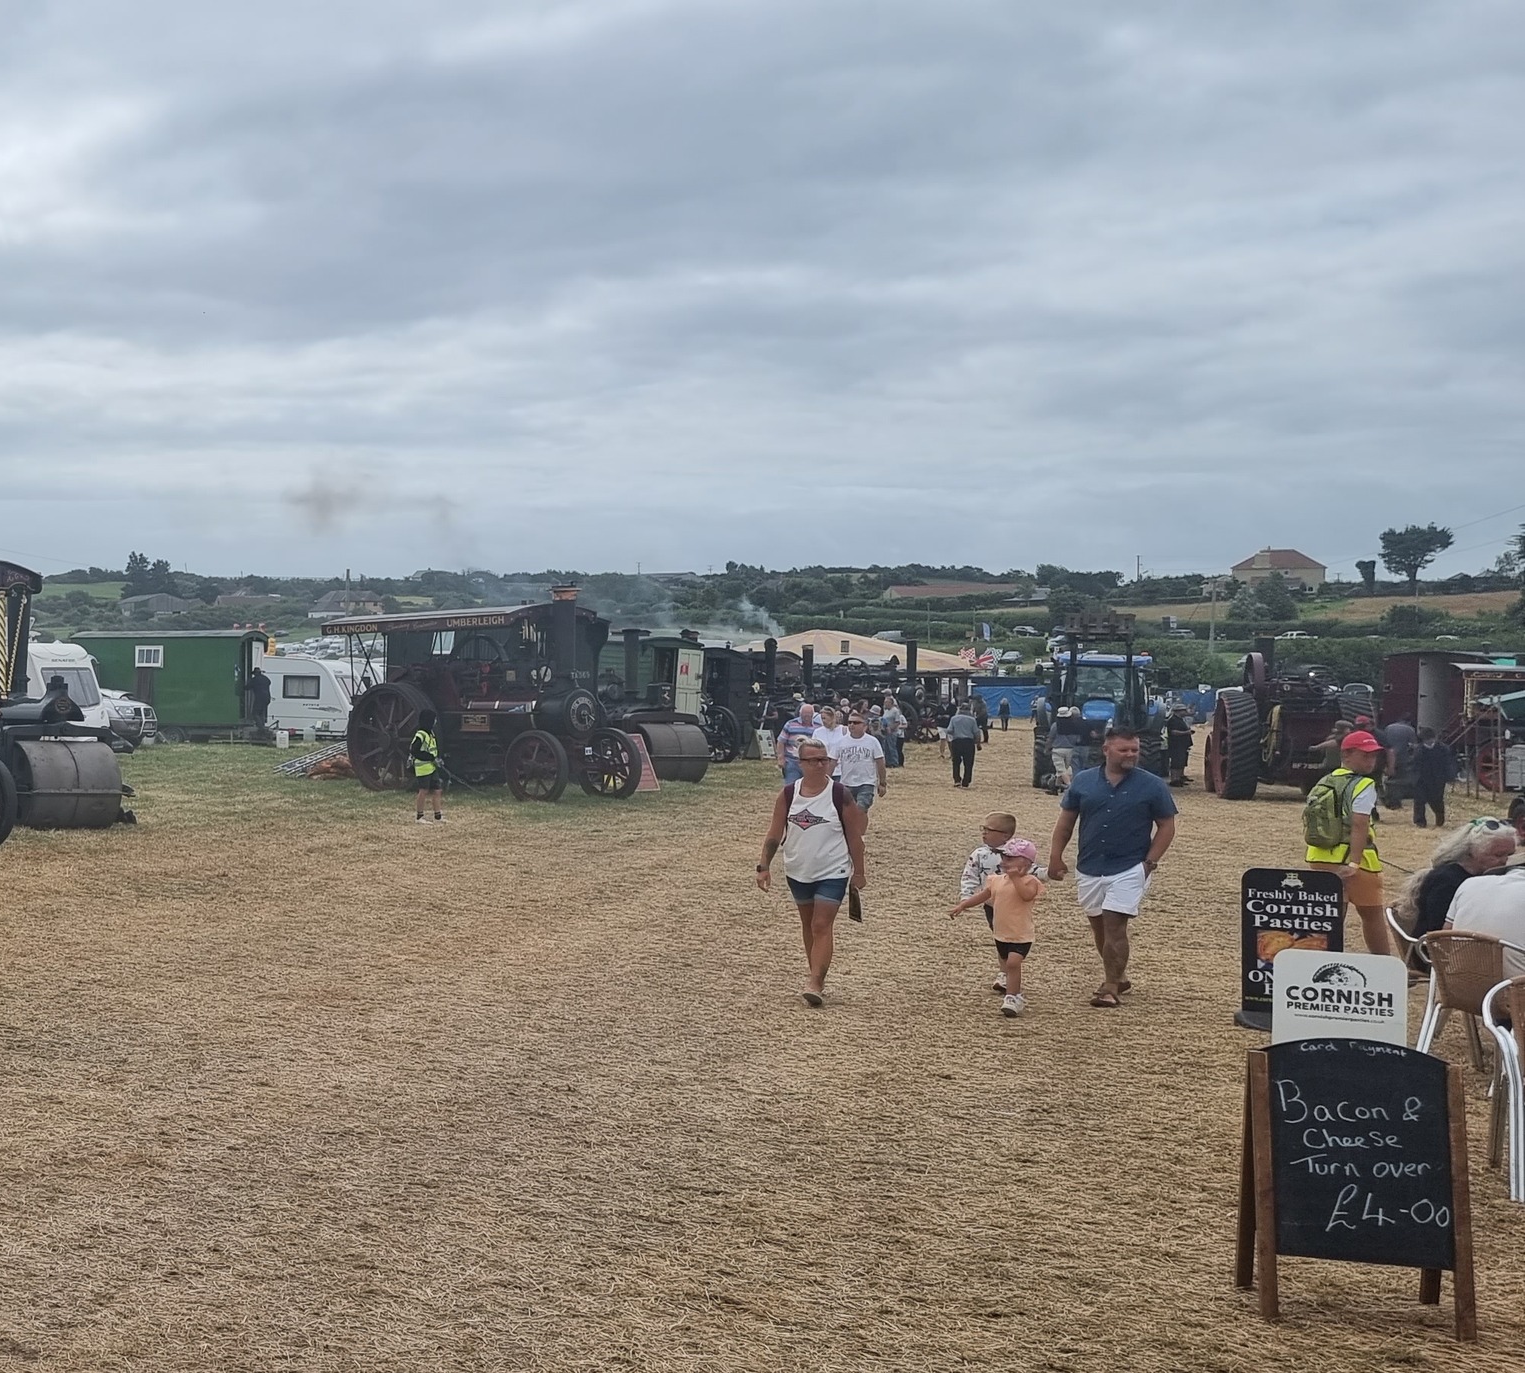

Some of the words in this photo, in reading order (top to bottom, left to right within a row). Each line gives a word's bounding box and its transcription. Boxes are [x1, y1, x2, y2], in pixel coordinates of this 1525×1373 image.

[446, 615, 505, 627] UMBERLEIGH
[1248, 888, 1294, 902] Freshly
[1298, 891, 1338, 902] Baked
[1246, 899, 1339, 917] Cornish
[1253, 914, 1332, 931] Pasties
[1286, 985, 1393, 1008] CORNISH
[1286, 1001, 1340, 1014] PREMIER
[1343, 1005, 1394, 1017] PASTIES
[1300, 1042, 1339, 1052] Card
[1277, 1079, 1389, 1124] Bacon
[1402, 1096, 1422, 1122] &
[1303, 1128, 1402, 1149] Cheese
[1289, 1153, 1361, 1178] Turn
[1372, 1161, 1431, 1178] over
